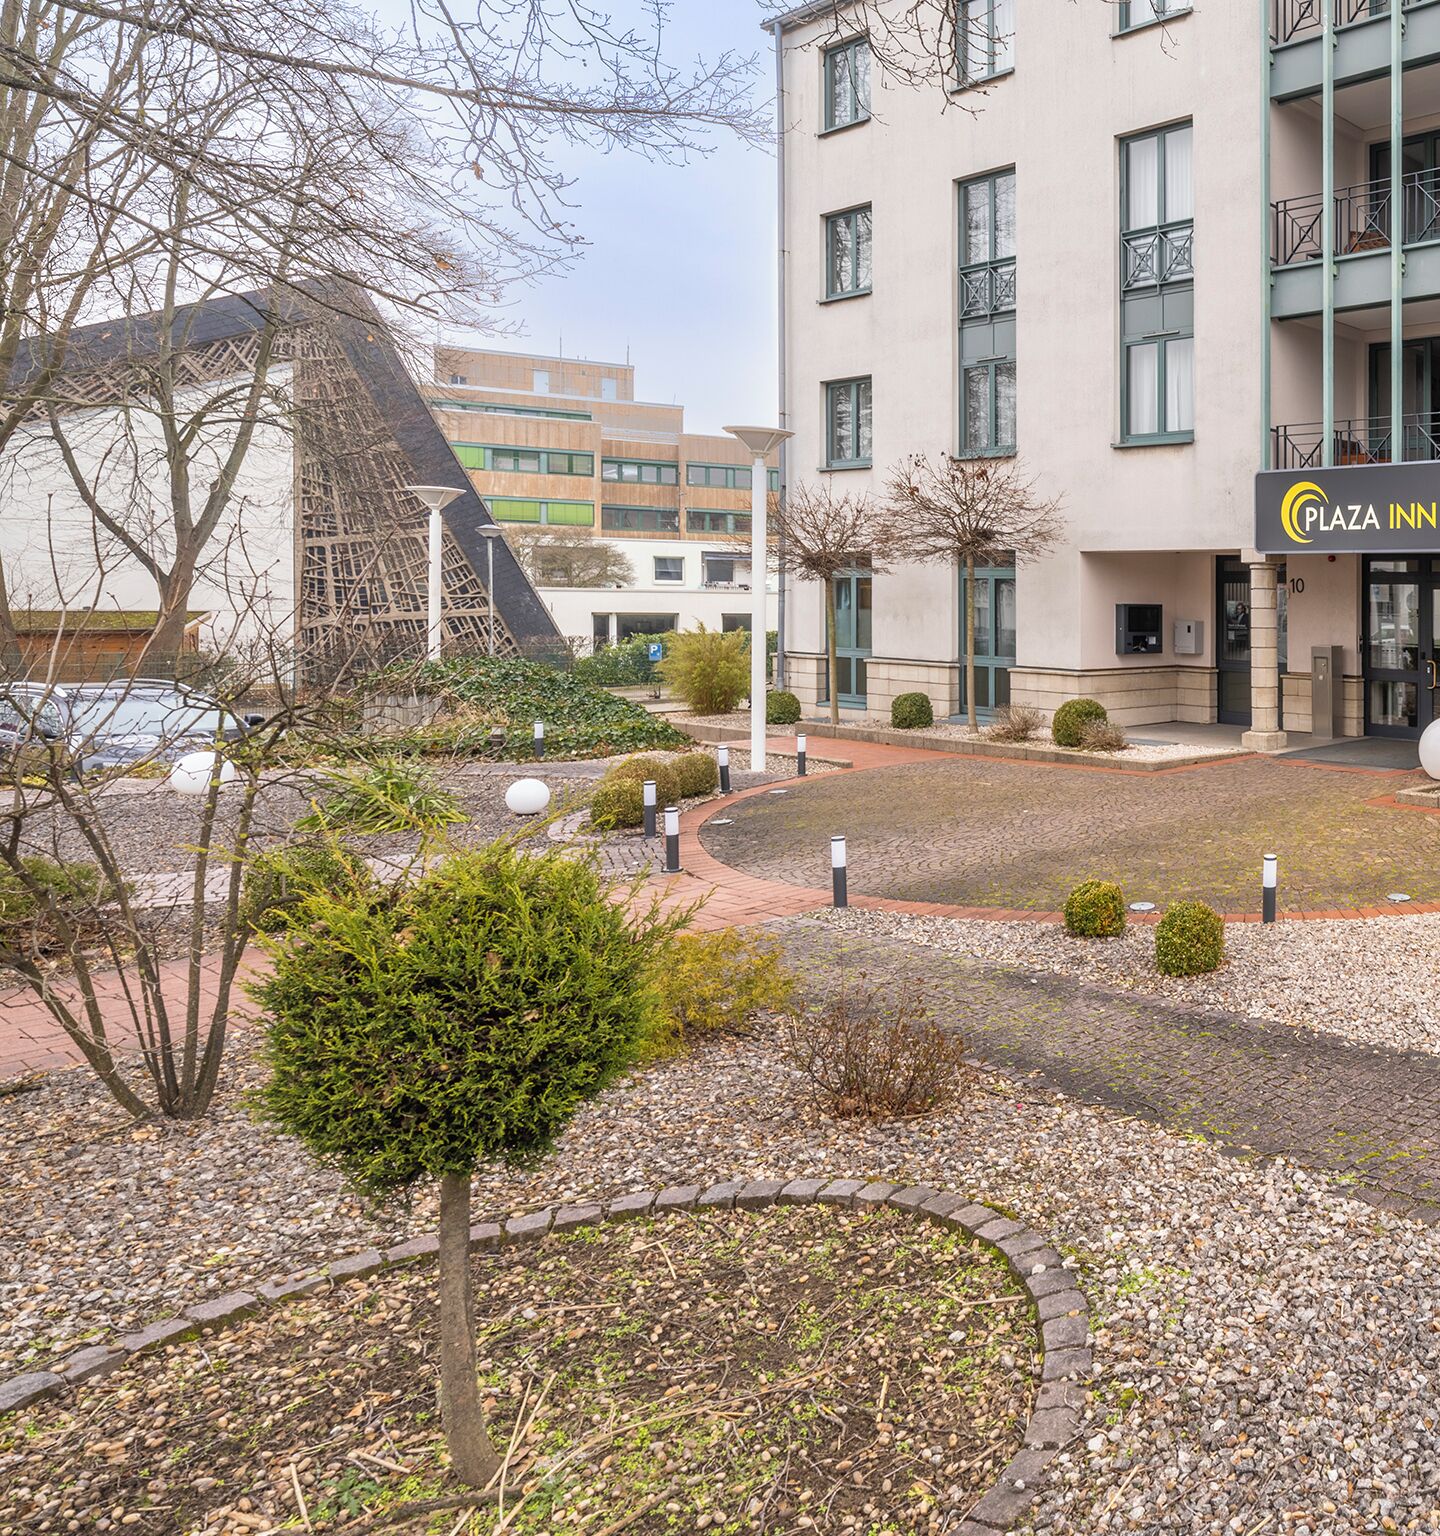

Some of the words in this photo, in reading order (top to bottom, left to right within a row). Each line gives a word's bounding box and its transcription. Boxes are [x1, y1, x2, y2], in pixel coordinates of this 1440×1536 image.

[1305, 504, 1380, 531] PLAZA
[1389, 502, 1437, 529] INN
[1290, 577, 1305, 593] 10
[650, 645, 658, 654] P
